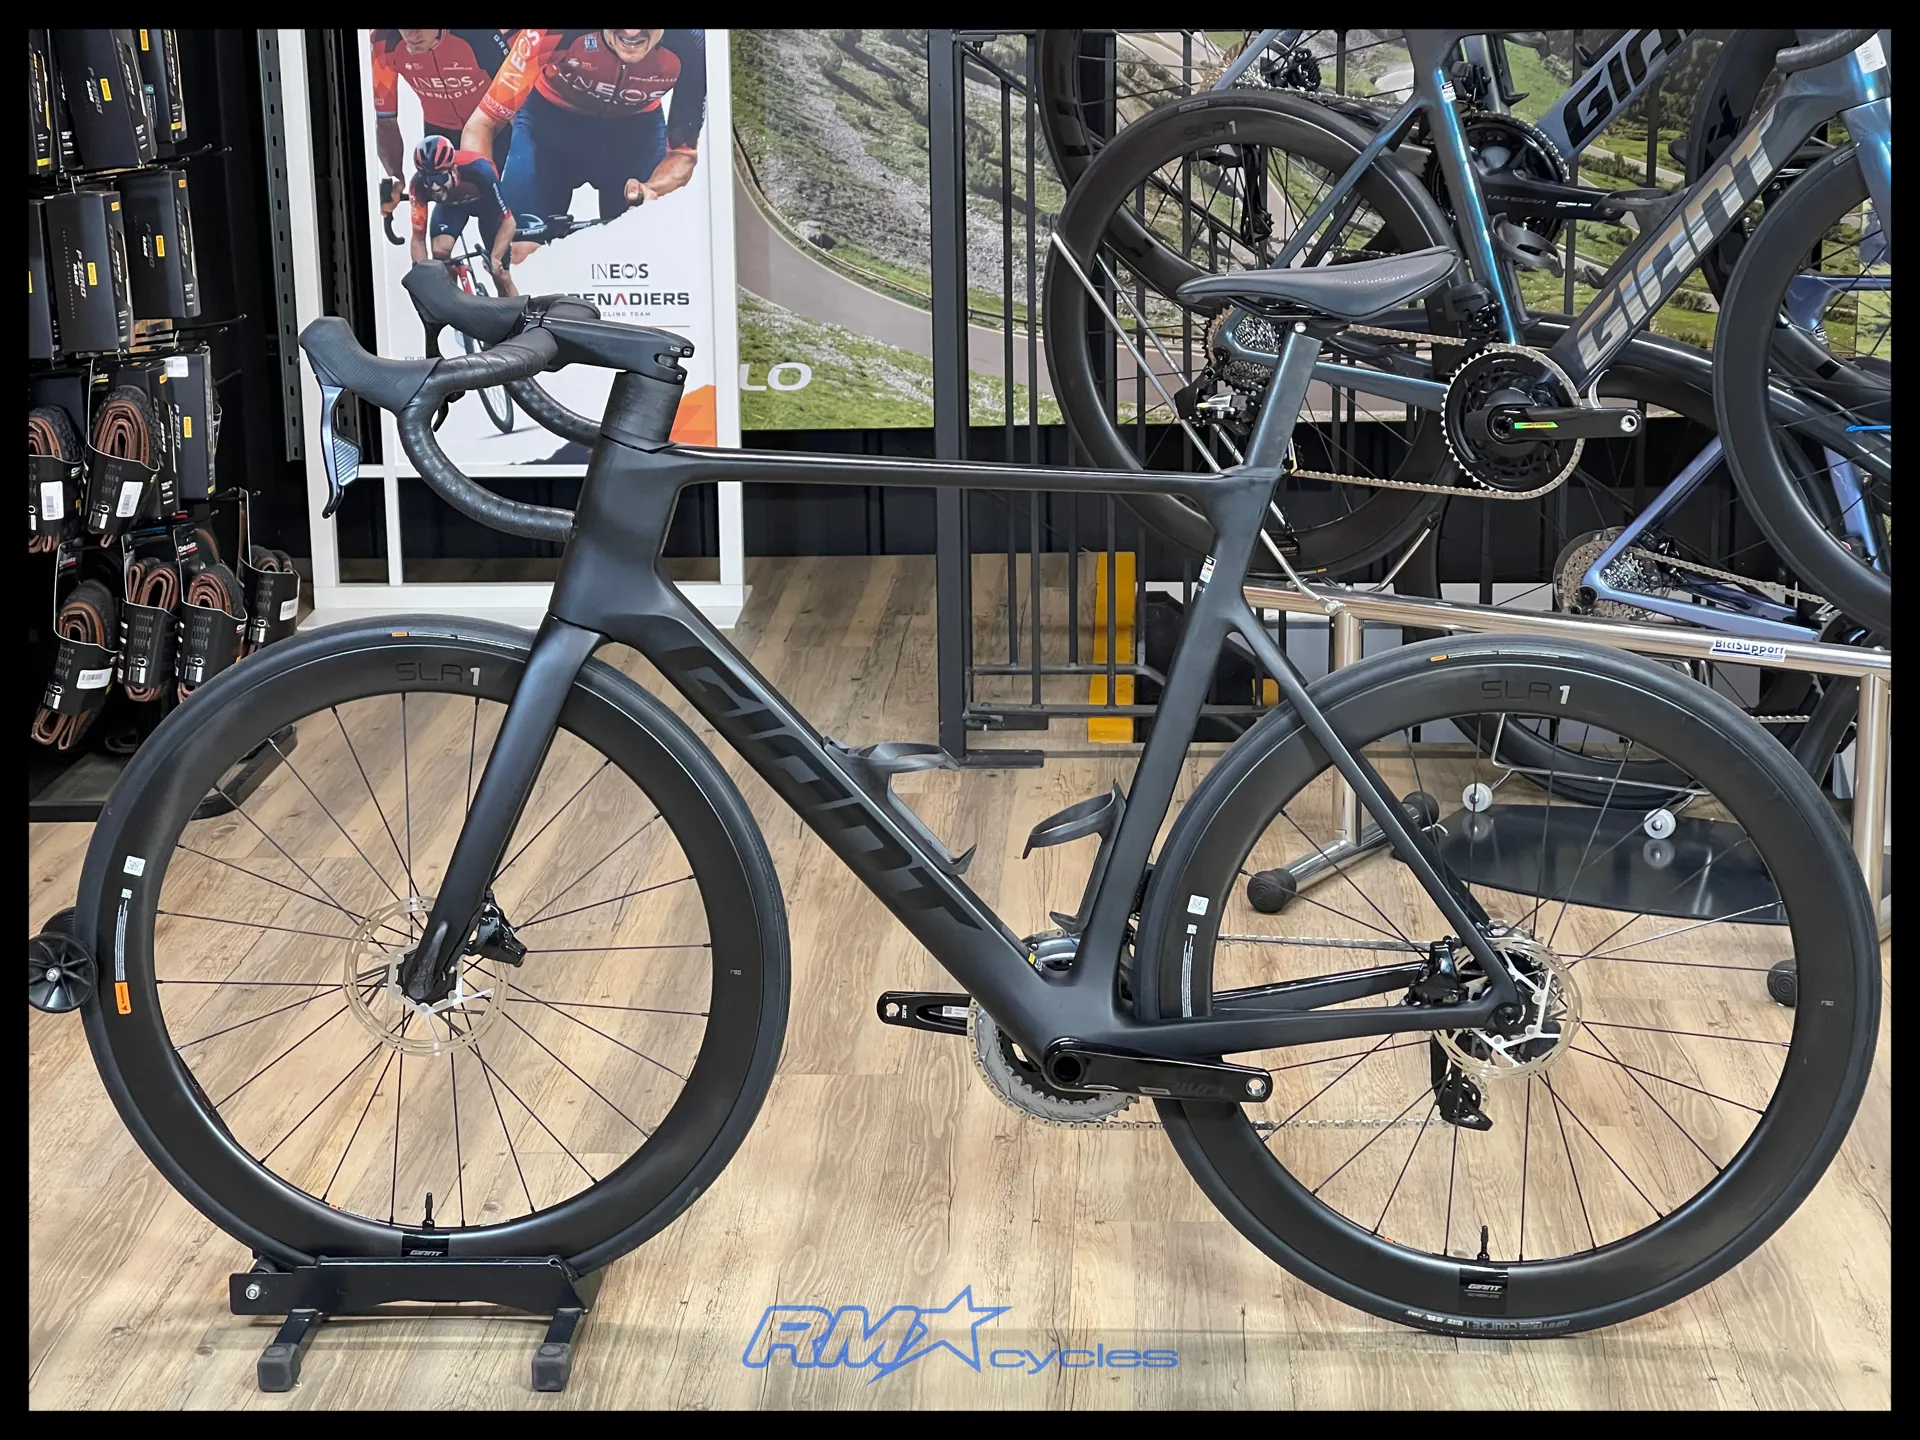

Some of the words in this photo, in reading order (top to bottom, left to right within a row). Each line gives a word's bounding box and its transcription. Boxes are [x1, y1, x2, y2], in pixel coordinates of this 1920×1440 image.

[412, 76, 473, 88] INEOS
[1563, 28, 1698, 148] GIA
[1577, 104, 1778, 370] GIANT
[77, 261, 87, 299] ZERO
[591, 263, 648, 279] INEOS
[395, 662, 463, 682] SLR
[469, 667, 480, 686] 1
[1481, 680, 1553, 700] SLR
[1559, 685, 1571, 705] 1
[655, 646, 984, 932] GIANT
[410, 1249, 443, 1257] GIANT
[1467, 1283, 1503, 1292] GIANT
